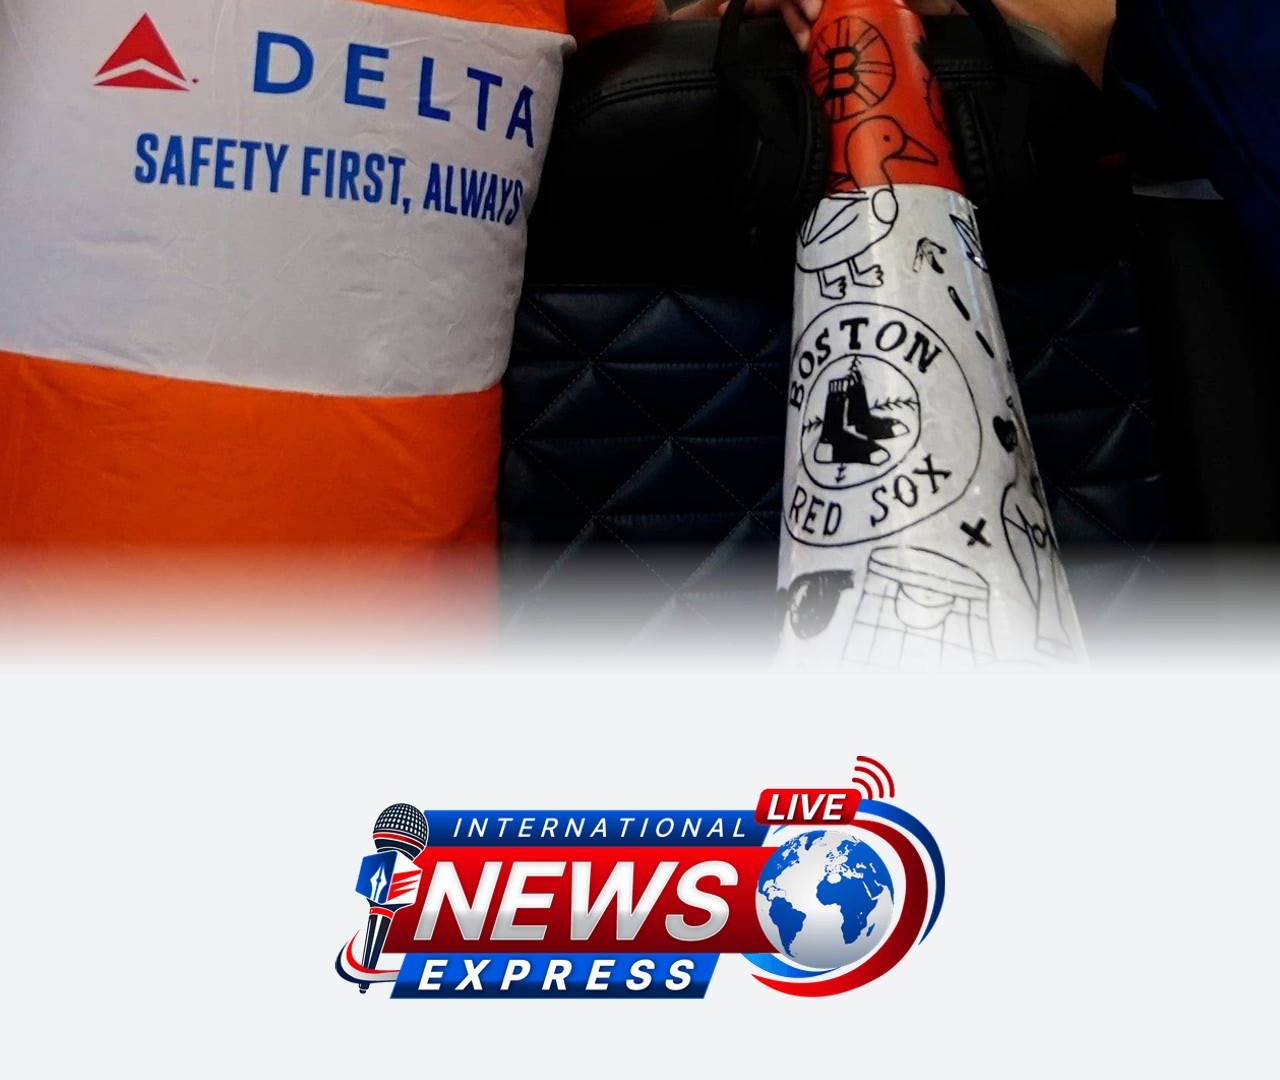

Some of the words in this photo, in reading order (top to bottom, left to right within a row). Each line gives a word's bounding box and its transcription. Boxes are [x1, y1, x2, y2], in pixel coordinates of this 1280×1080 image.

[252, 30, 536, 149] DELTA
[821, 44, 861, 101] B
[133, 131, 290, 194] SAFETY
[300, 146, 413, 216] FIRST,
[422, 162, 525, 227] ALWAYS
[788, 317, 943, 412] BOSTON
[788, 485, 843, 537] RED
[869, 452, 953, 528] SOX
